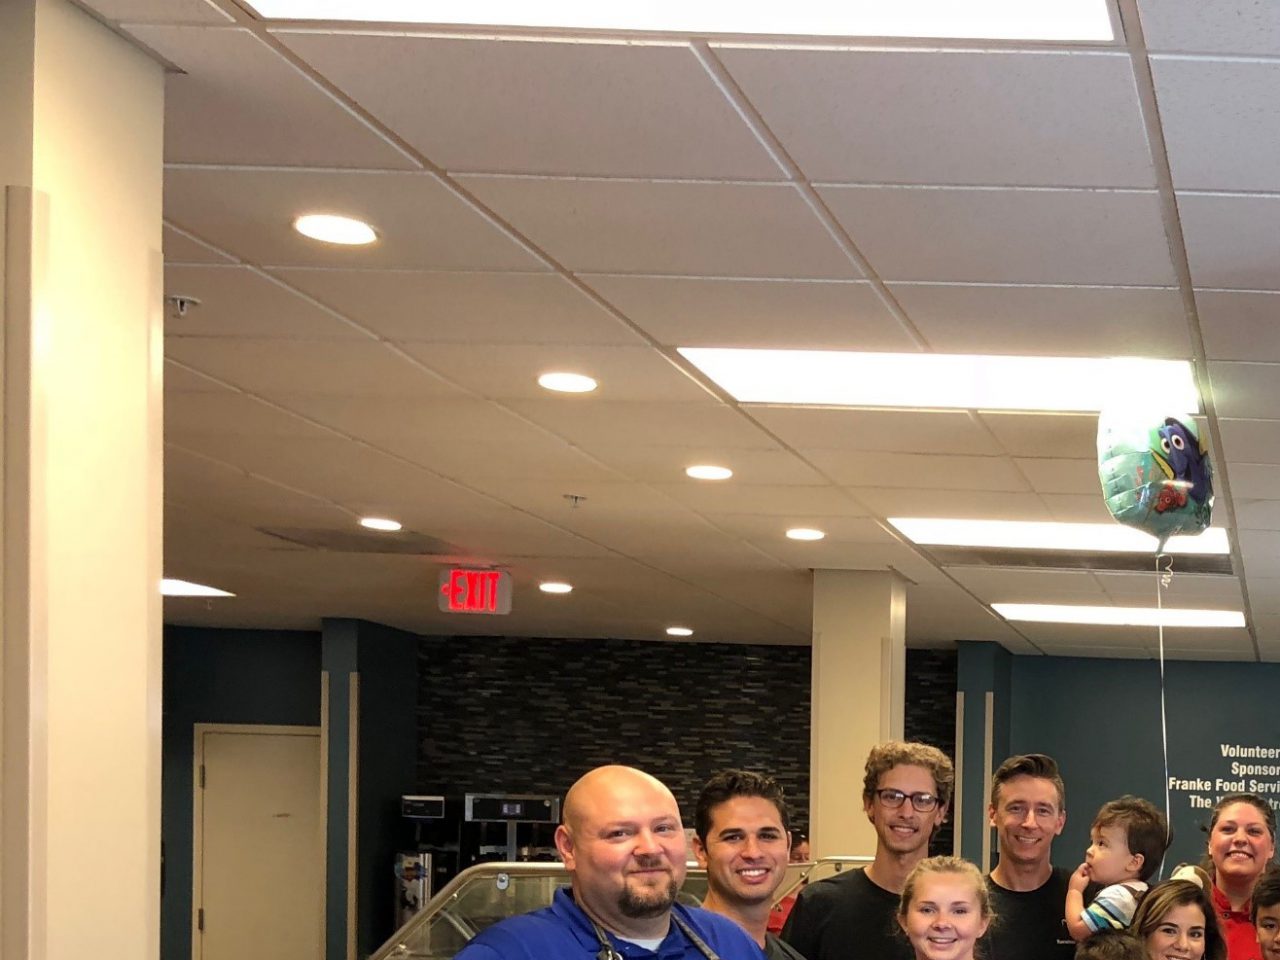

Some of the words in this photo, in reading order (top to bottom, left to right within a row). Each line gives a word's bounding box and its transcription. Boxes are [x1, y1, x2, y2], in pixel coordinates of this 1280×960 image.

[448, 569, 501, 612] EXIT
[1220, 744, 1280, 759] Volunteer
[1168, 777, 1212, 791] Franke
[1215, 778, 1245, 792] Food
[1189, 795, 1212, 809] The
